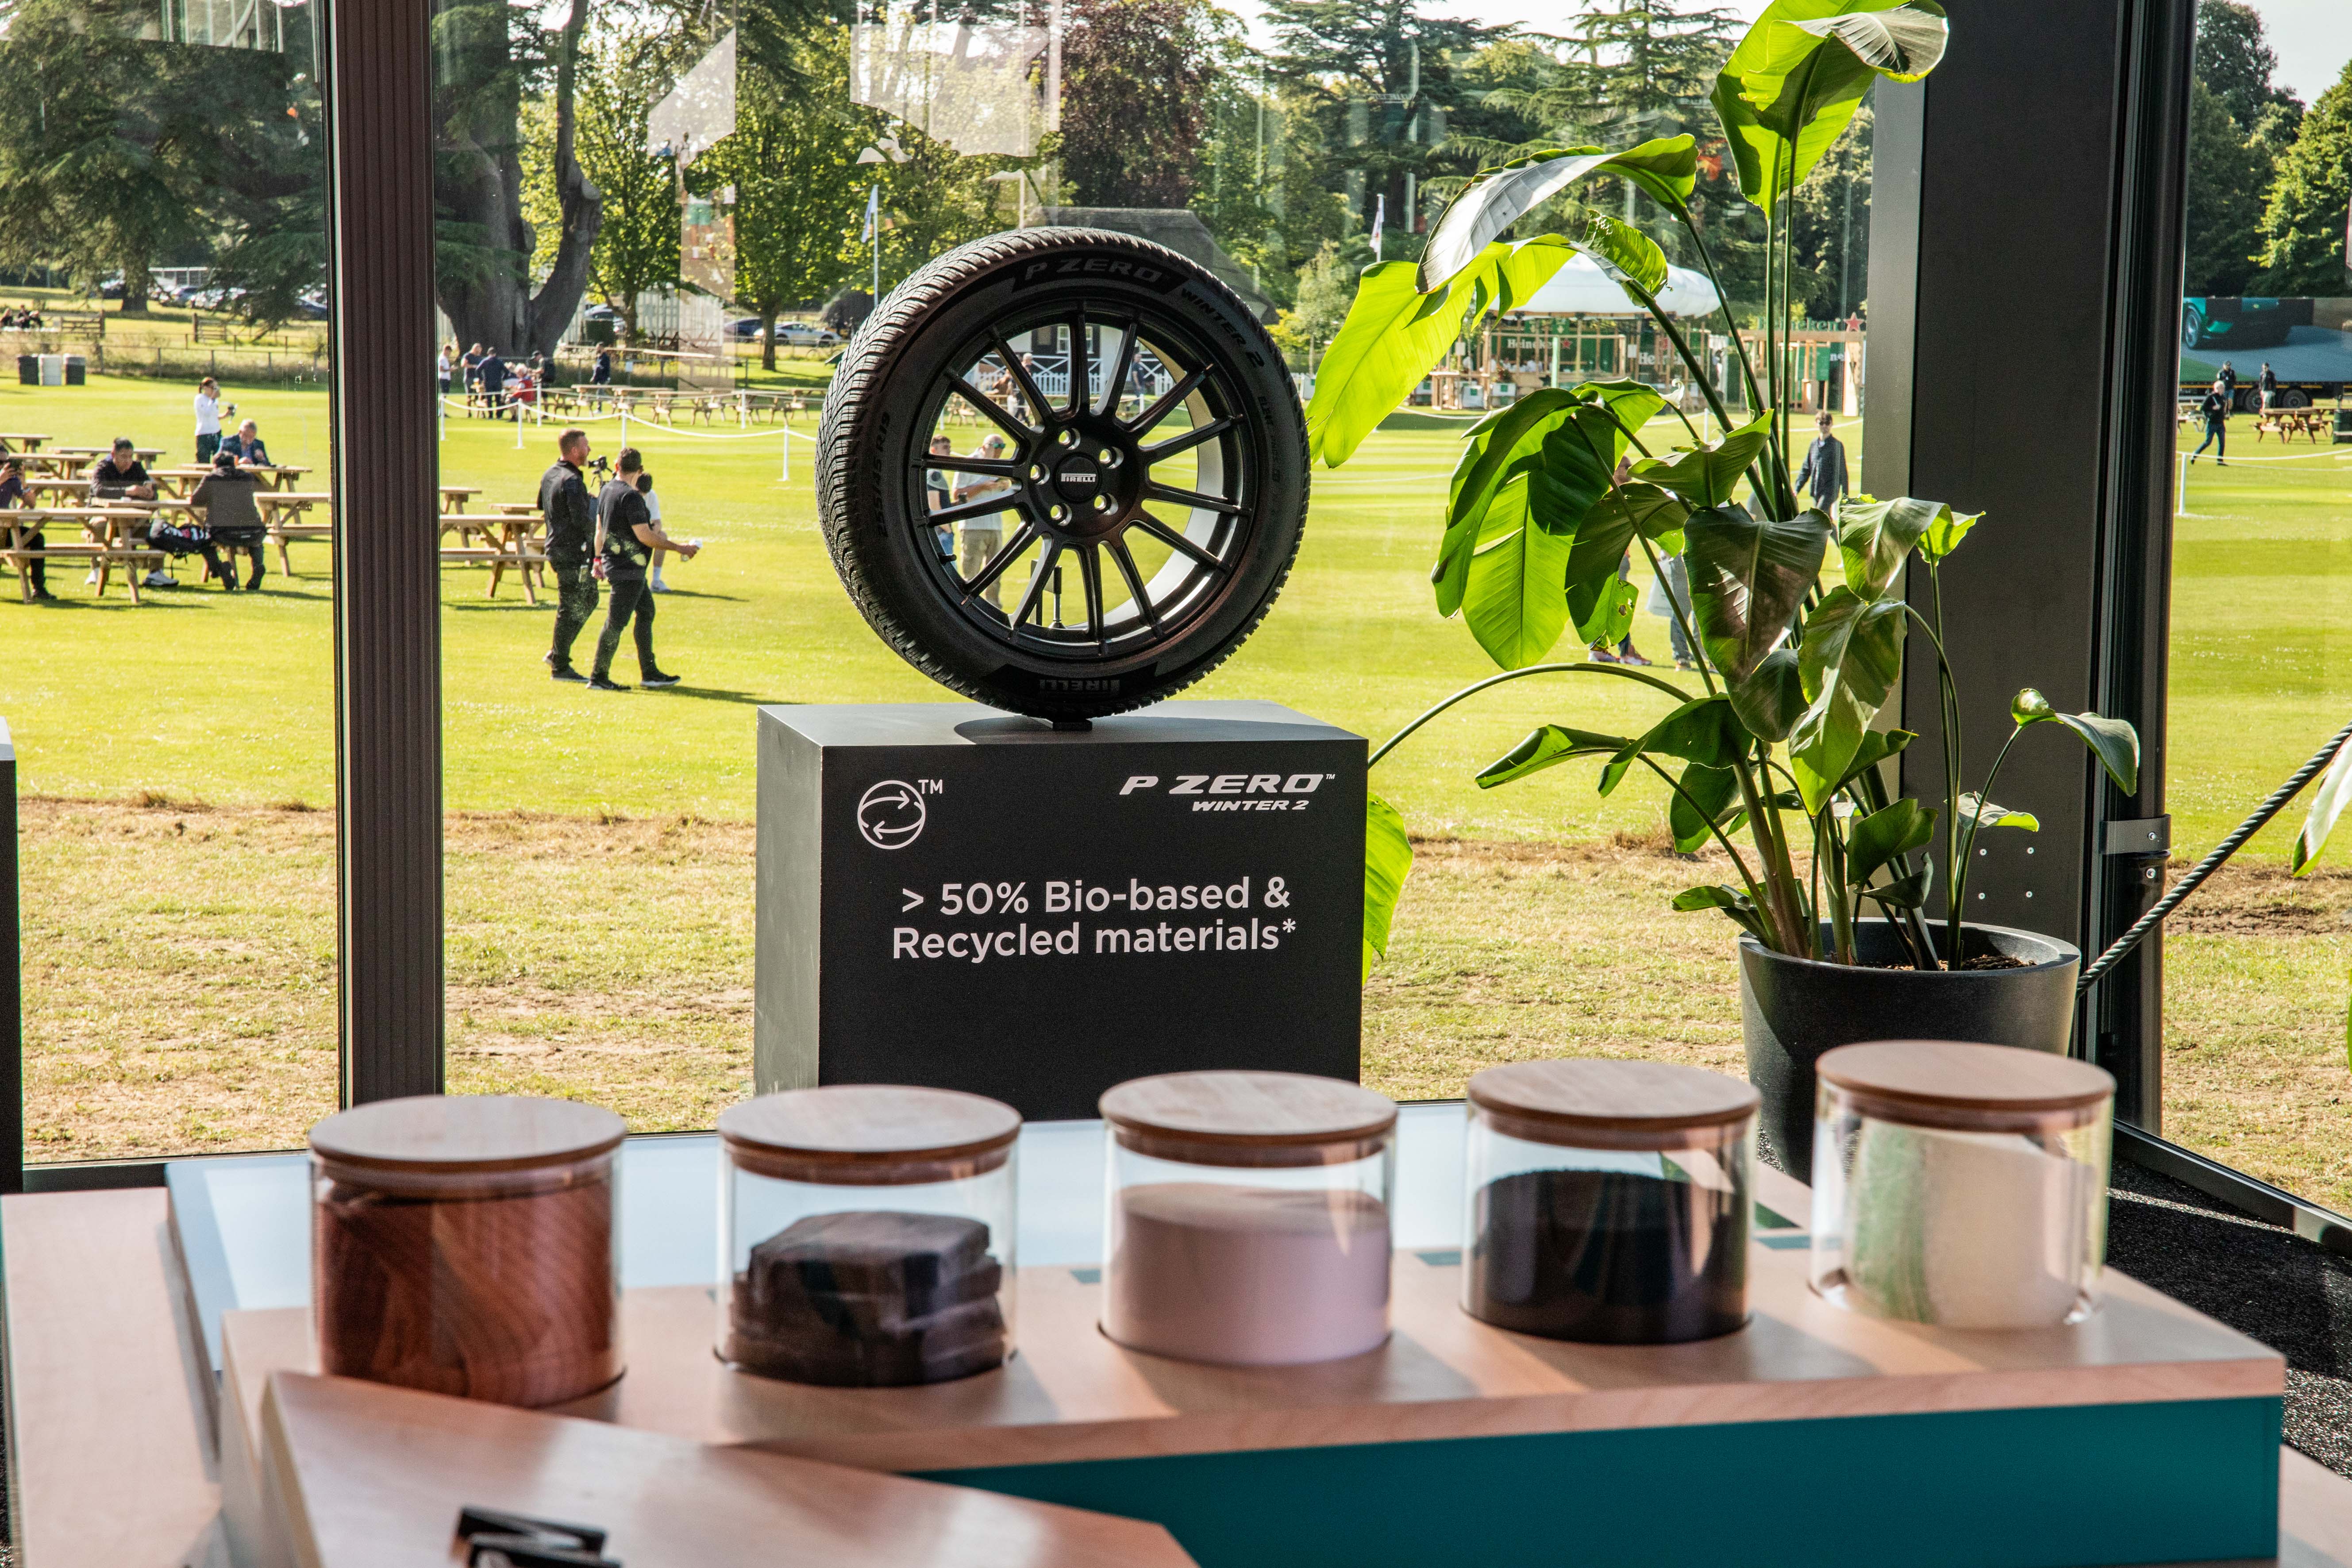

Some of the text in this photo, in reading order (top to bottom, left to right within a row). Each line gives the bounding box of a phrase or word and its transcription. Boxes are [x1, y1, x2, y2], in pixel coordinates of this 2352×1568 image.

[1024, 258, 1163, 282] P ZERO
[1181, 288, 1265, 367] WINTER 2
[1061, 473, 1096, 482] PIRELLI
[1039, 679, 1120, 695] PIRELLI
[1119, 776, 1159, 795] P
[1169, 774, 1324, 794] ZERO
[1192, 800, 1309, 811] WINTER 2
[940, 881, 1028, 915] 50%
[1046, 876, 1249, 913] Bio-based
[1264, 876, 1290, 908] &
[893, 922, 1079, 963] Recycled
